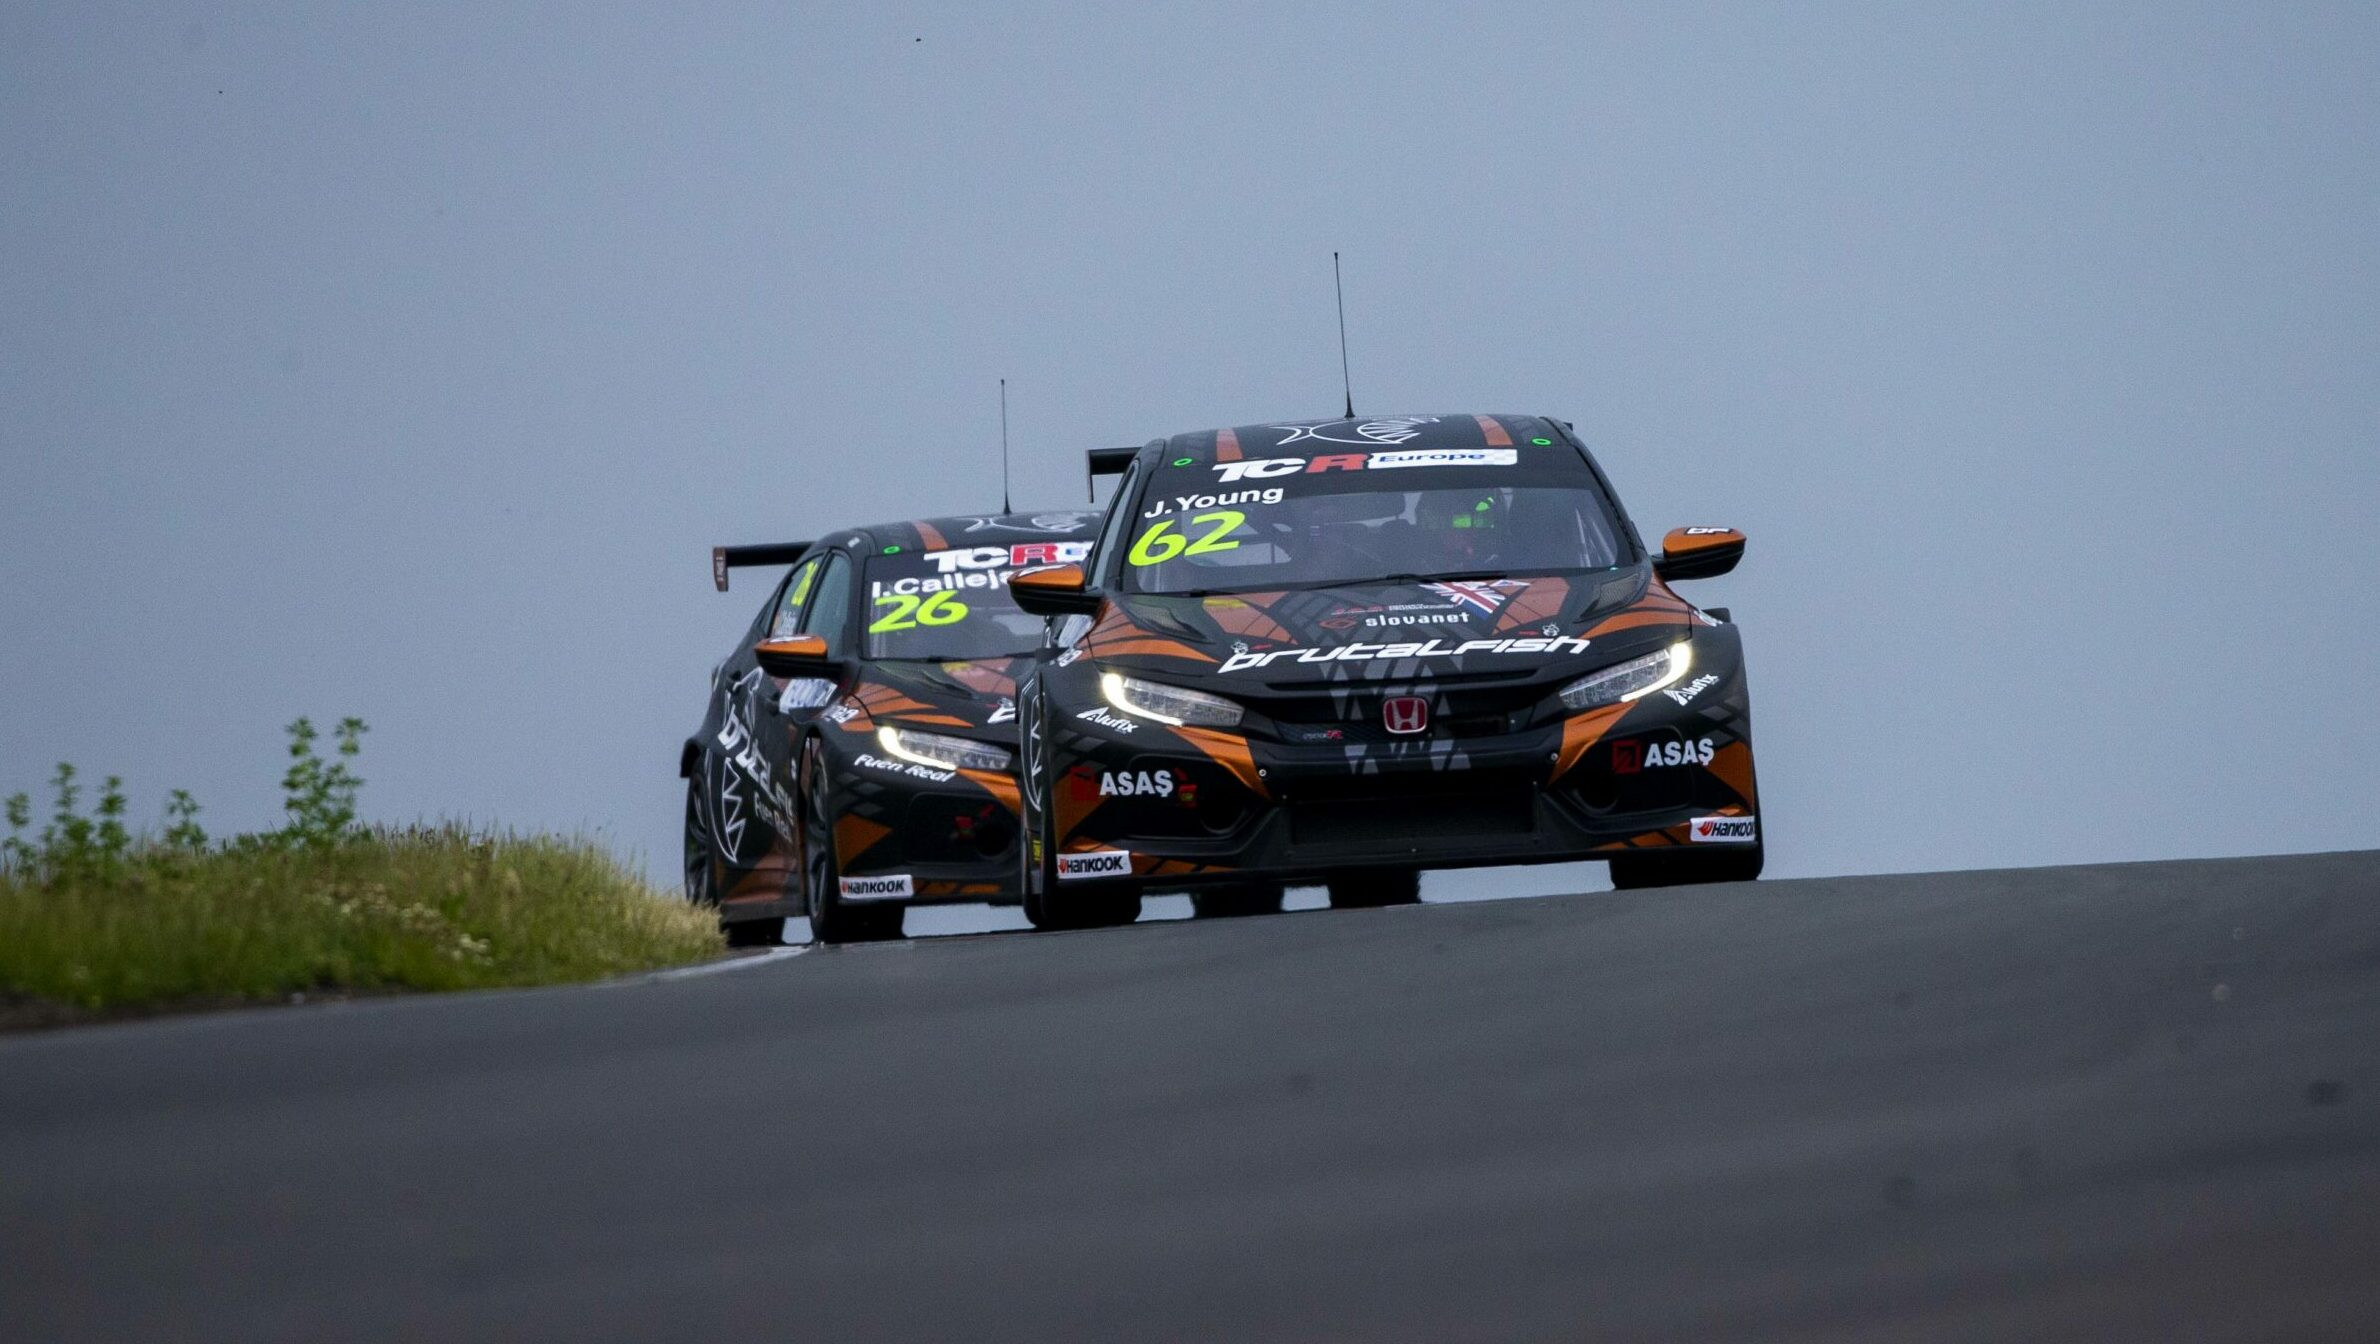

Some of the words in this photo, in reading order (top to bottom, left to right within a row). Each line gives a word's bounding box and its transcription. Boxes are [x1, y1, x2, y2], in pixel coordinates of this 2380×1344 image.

[1212, 454, 1367, 483] TCR
[1379, 452, 1485, 463] Europe
[1144, 487, 1284, 519] J.Young
[1128, 510, 1246, 566] 62
[924, 543, 1059, 573] TCR
[869, 590, 968, 634] 26
[1365, 612, 1470, 628] slovanet
[854, 754, 904, 772] Fuen
[904, 764, 956, 782] Real
[1645, 738, 1715, 768] ASAŞ
[1099, 770, 1174, 798] ASAŞ
